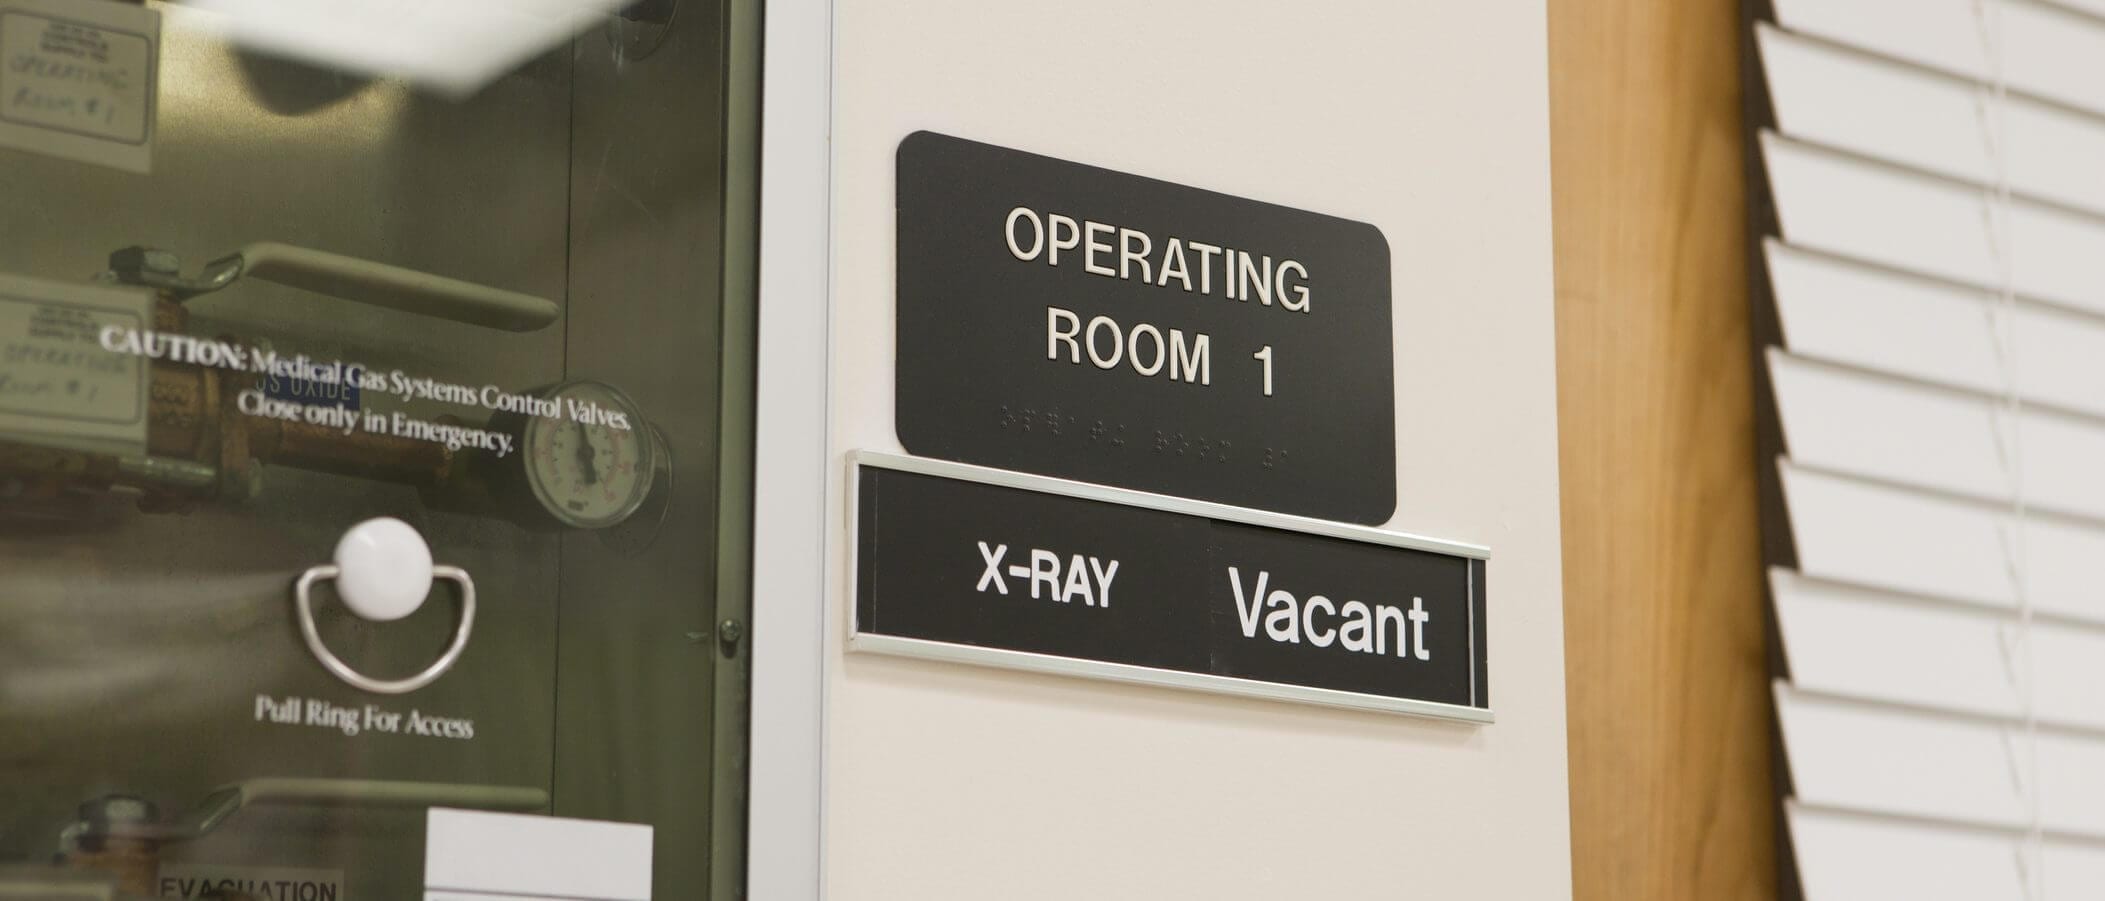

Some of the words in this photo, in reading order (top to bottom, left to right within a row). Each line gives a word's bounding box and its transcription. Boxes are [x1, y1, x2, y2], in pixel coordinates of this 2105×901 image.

[1005, 206, 1310, 314] OPERATING
[100, 325, 248, 371] CAUTION:
[251, 347, 341, 385] Medical
[345, 363, 388, 391] Gas
[390, 369, 478, 407] Systems
[480, 385, 562, 419] Control
[1046, 305, 1210, 386] ROOM
[1253, 344, 1273, 397] 1
[237, 388, 303, 421] Close
[304, 403, 360, 435] only
[363, 408, 387, 434] in
[392, 412, 514, 458] Emergency.
[976, 541, 1119, 608] X-RAY
[1228, 566, 1430, 661] Vacant
[254, 693, 301, 724] Pull
[305, 698, 360, 737] Ring
[363, 704, 403, 733] For
[405, 708, 475, 740] Access
